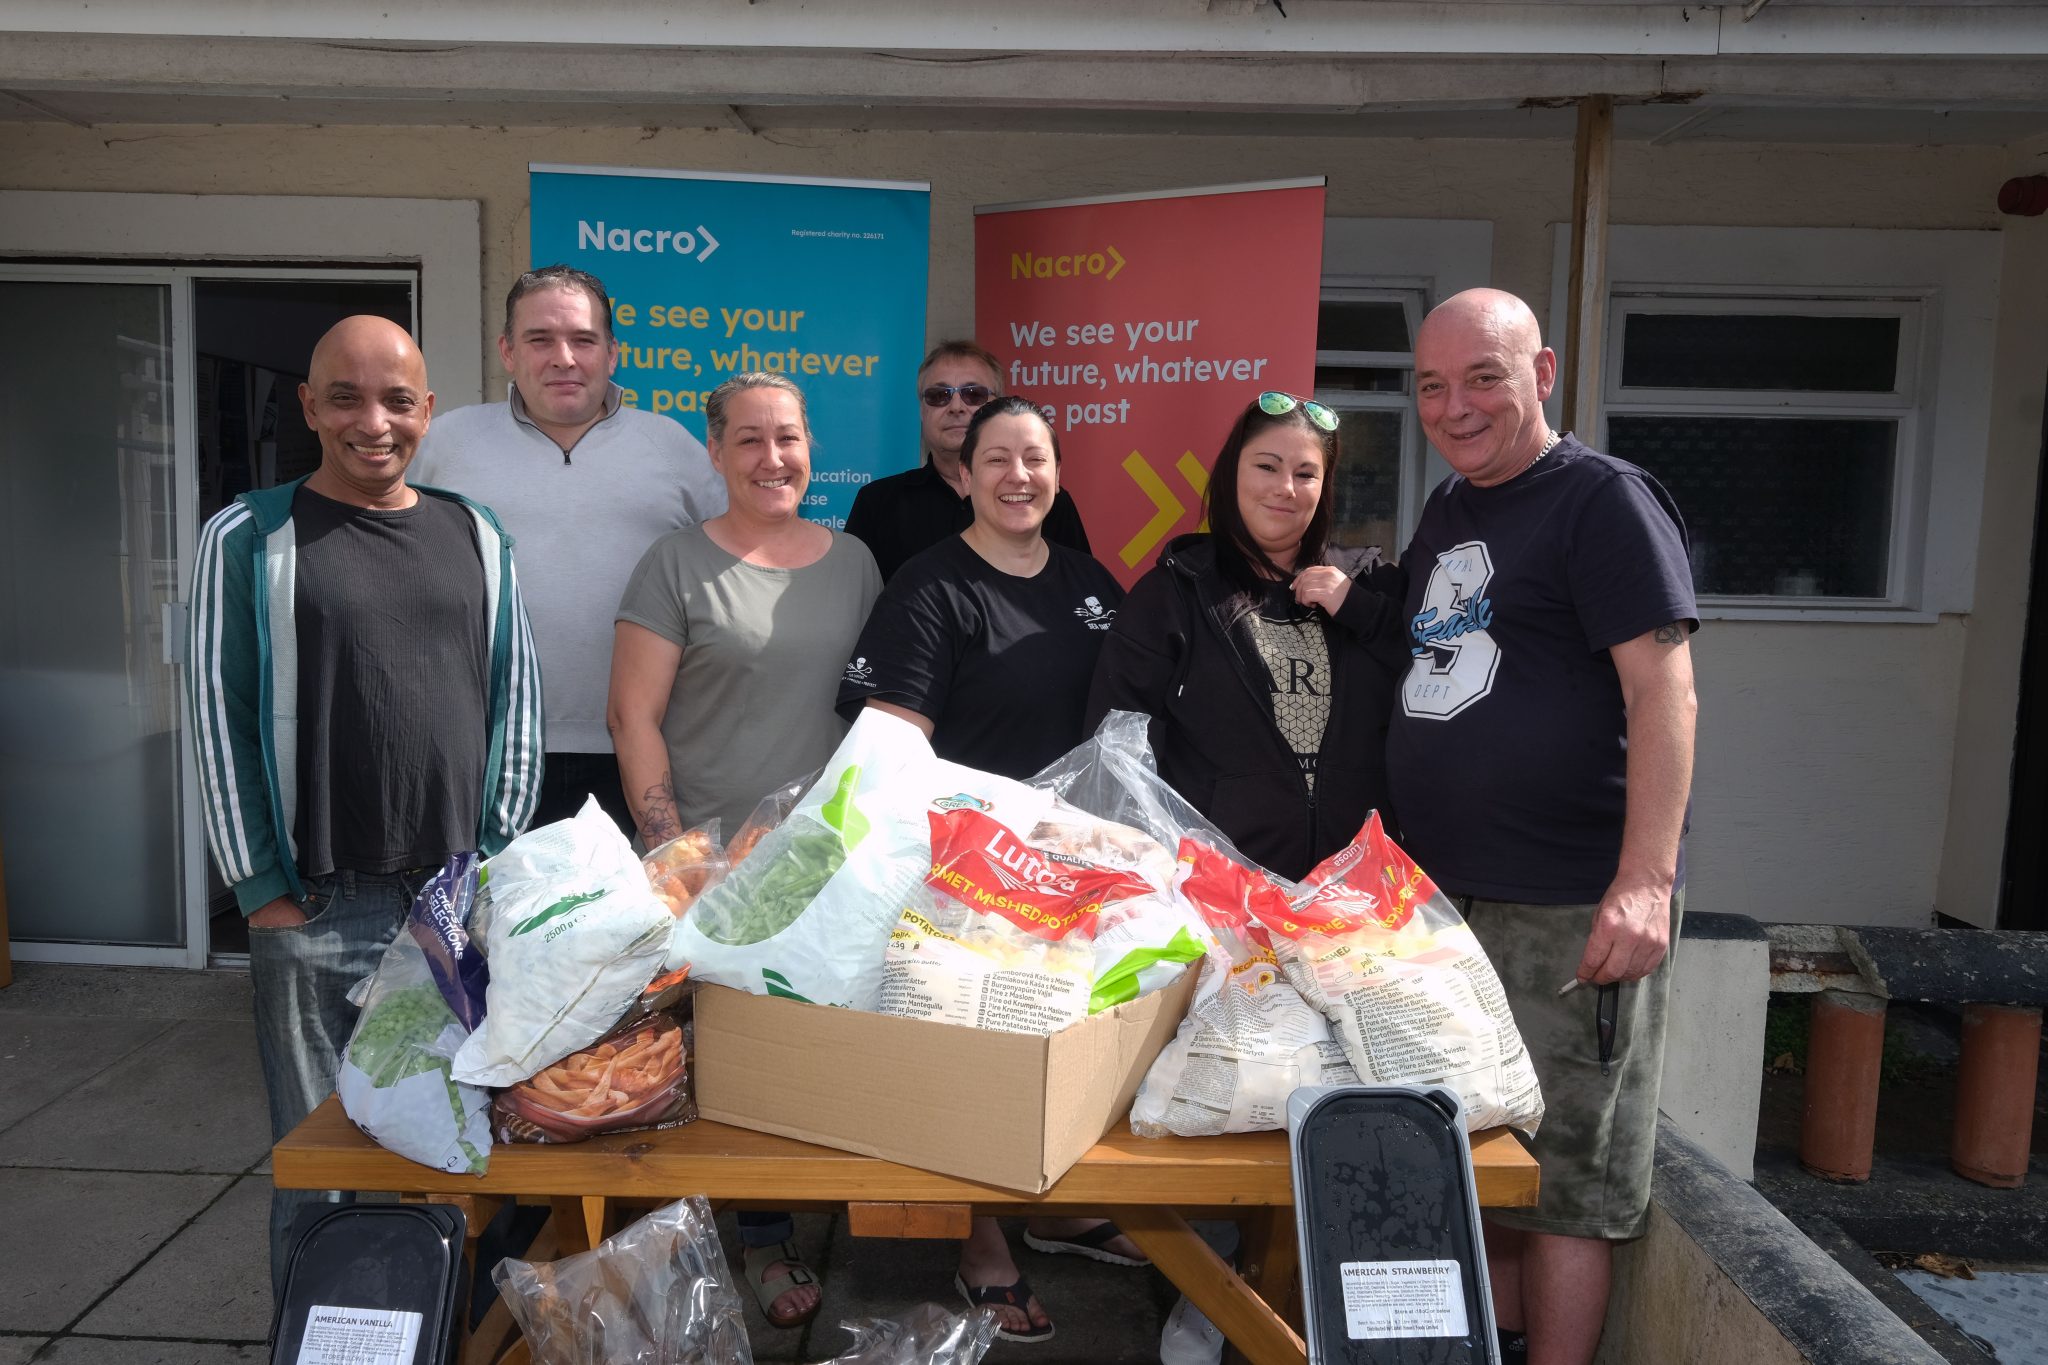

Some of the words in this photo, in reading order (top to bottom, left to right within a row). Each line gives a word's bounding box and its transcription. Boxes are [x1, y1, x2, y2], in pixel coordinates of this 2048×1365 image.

[578, 220, 696, 255] Nacro
[791, 229, 826, 238] Registered
[828, 230, 851, 239] charity
[1011, 252, 1105, 280] Nacro
[649, 305, 710, 329] see
[720, 306, 804, 338] your
[1010, 321, 1056, 348] We
[1066, 322, 1115, 346] see
[1125, 319, 1199, 351] your
[618, 342, 702, 377] ture,
[710, 343, 879, 377] whatever
[1010, 360, 1107, 390] future,
[1114, 356, 1267, 384] whatever
[652, 388, 712, 414] pas
[1066, 399, 1131, 432] past
[810, 469, 871, 483] ucation
[801, 494, 828, 506] use
[1414, 684, 1450, 700] DEPT
[985, 829, 1080, 892] Lutosa
[428, 894, 464, 960] SELECTIONS
[544, 923, 567, 944] 2500
[1343, 1267, 1388, 1277] AMERICAN
[1391, 1266, 1450, 1276] STRAWBERRY
[314, 1315, 357, 1326] AMERICAN
[359, 1318, 393, 1328] VANILLA
